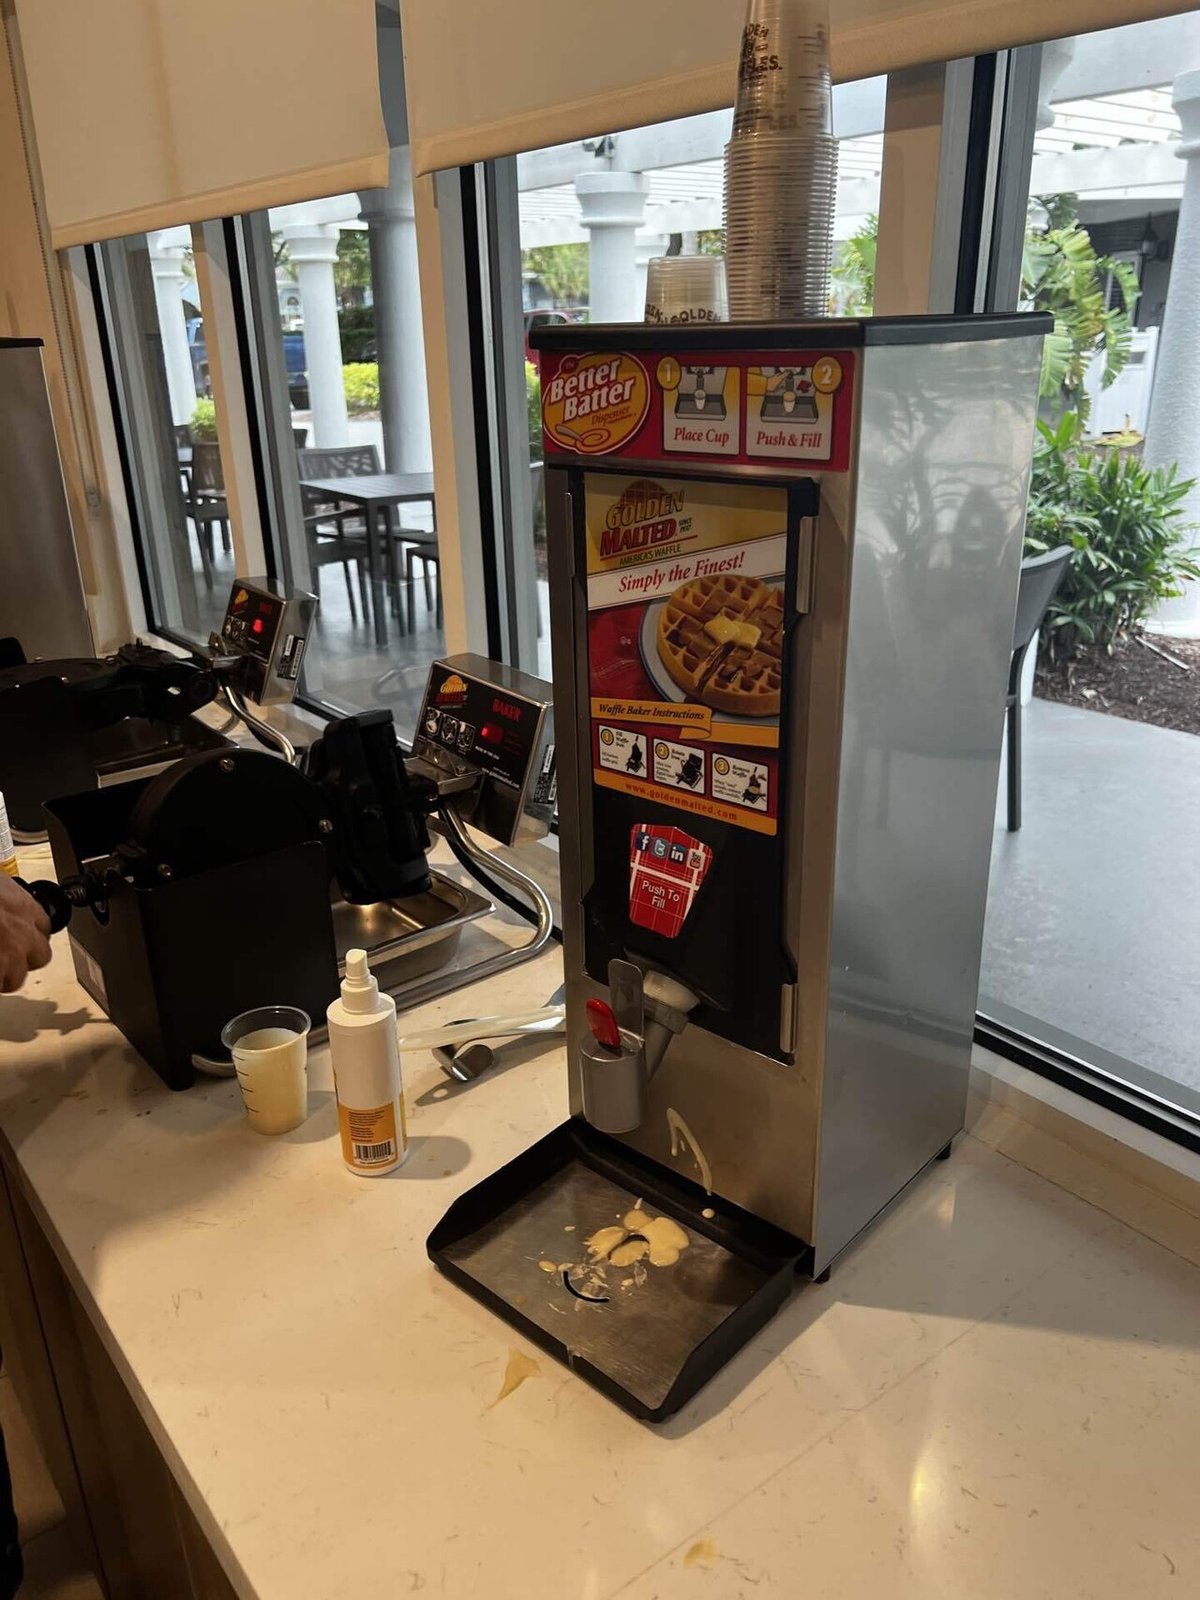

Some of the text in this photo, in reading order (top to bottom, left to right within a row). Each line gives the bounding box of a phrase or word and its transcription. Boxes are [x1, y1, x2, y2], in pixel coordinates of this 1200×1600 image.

[550, 357, 622, 404] Better
[663, 363, 672, 383] 1
[821, 366, 833, 386] 2
[563, 377, 635, 422] Batter
[674, 427, 730, 446] Place Cup
[756, 431, 822, 448] Push & Fill
[605, 488, 686, 531] GOLDEN
[600, 517, 678, 556] MALTED
[619, 543, 681, 566] AMERICA'S WAFFLE
[618, 551, 746, 593] Simply the Finest!
[492, 698, 521, 722] BAKER
[599, 704, 705, 720] Waffle Baker Instructions
[625, 782, 738, 821] www.goldenmalted.com
[671, 846, 684, 862] in
[642, 880, 680, 902] Push To
[651, 895, 666, 909] Fill
